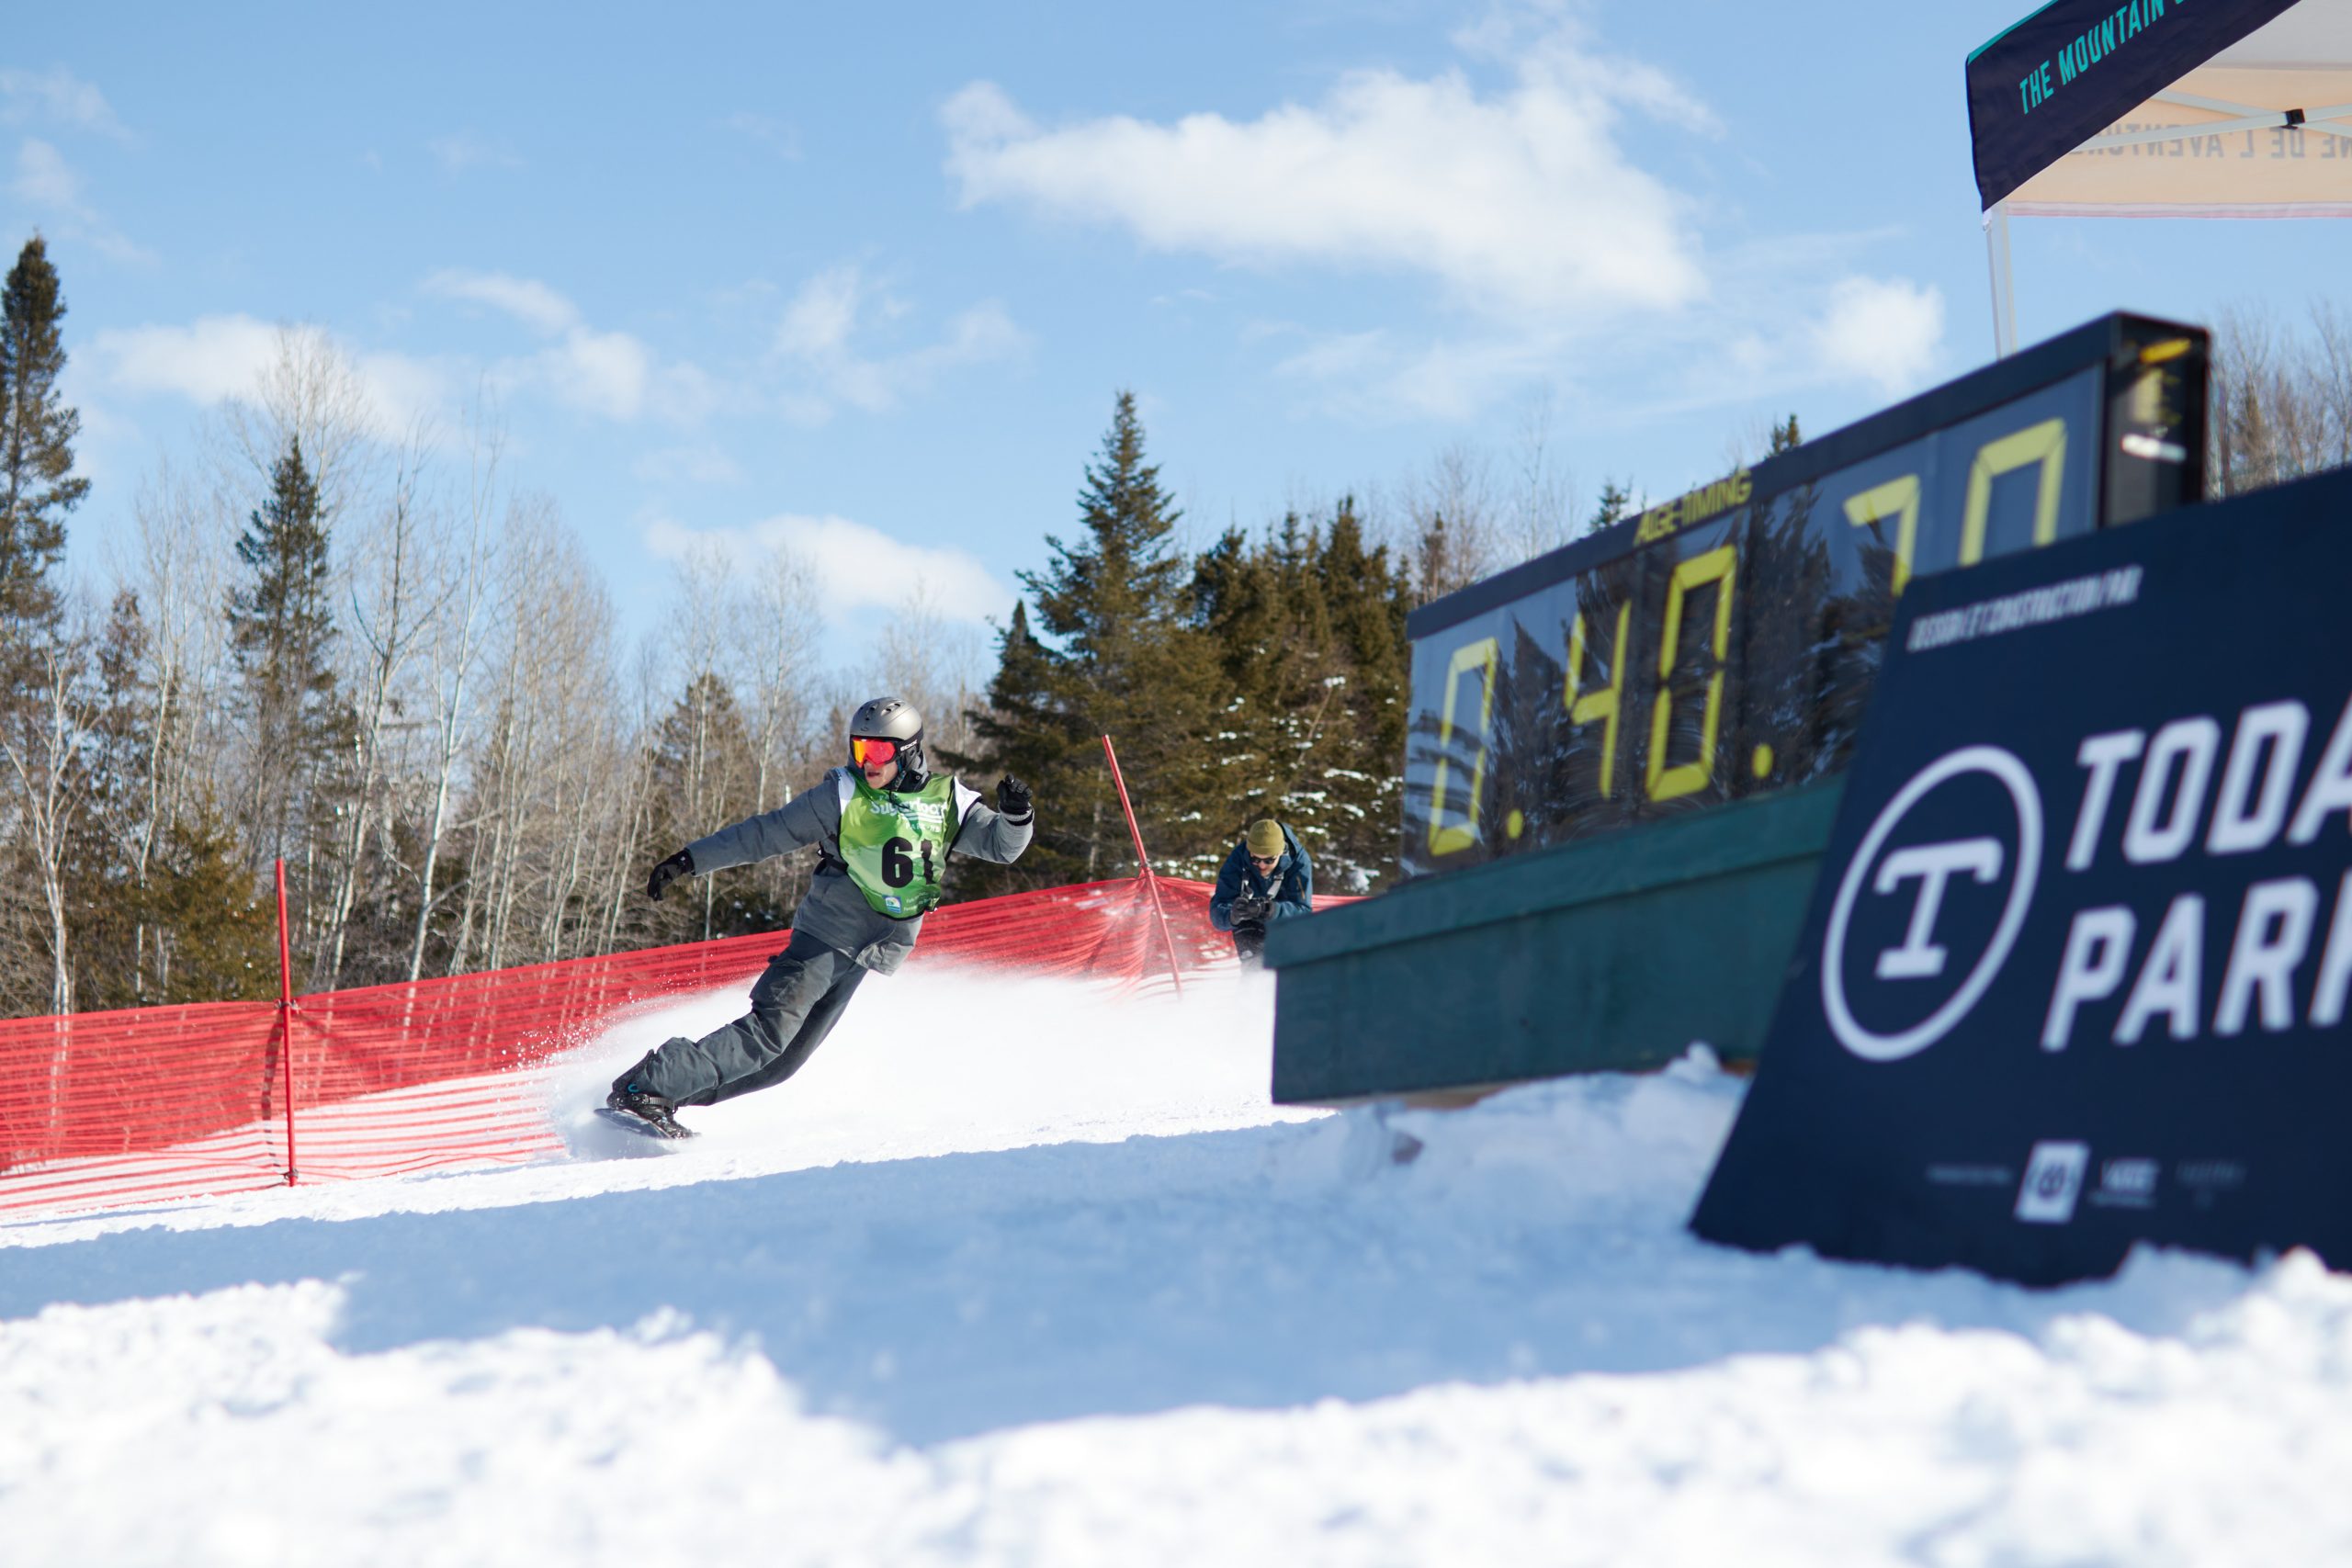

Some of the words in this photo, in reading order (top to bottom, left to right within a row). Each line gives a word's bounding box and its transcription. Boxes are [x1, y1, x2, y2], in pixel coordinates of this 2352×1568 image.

[2019, 60, 2055, 115] THE
[2058, 0, 2165, 86] MOUNTAIN
[881, 836, 936, 888] 61
[1873, 837, 2004, 979] T
